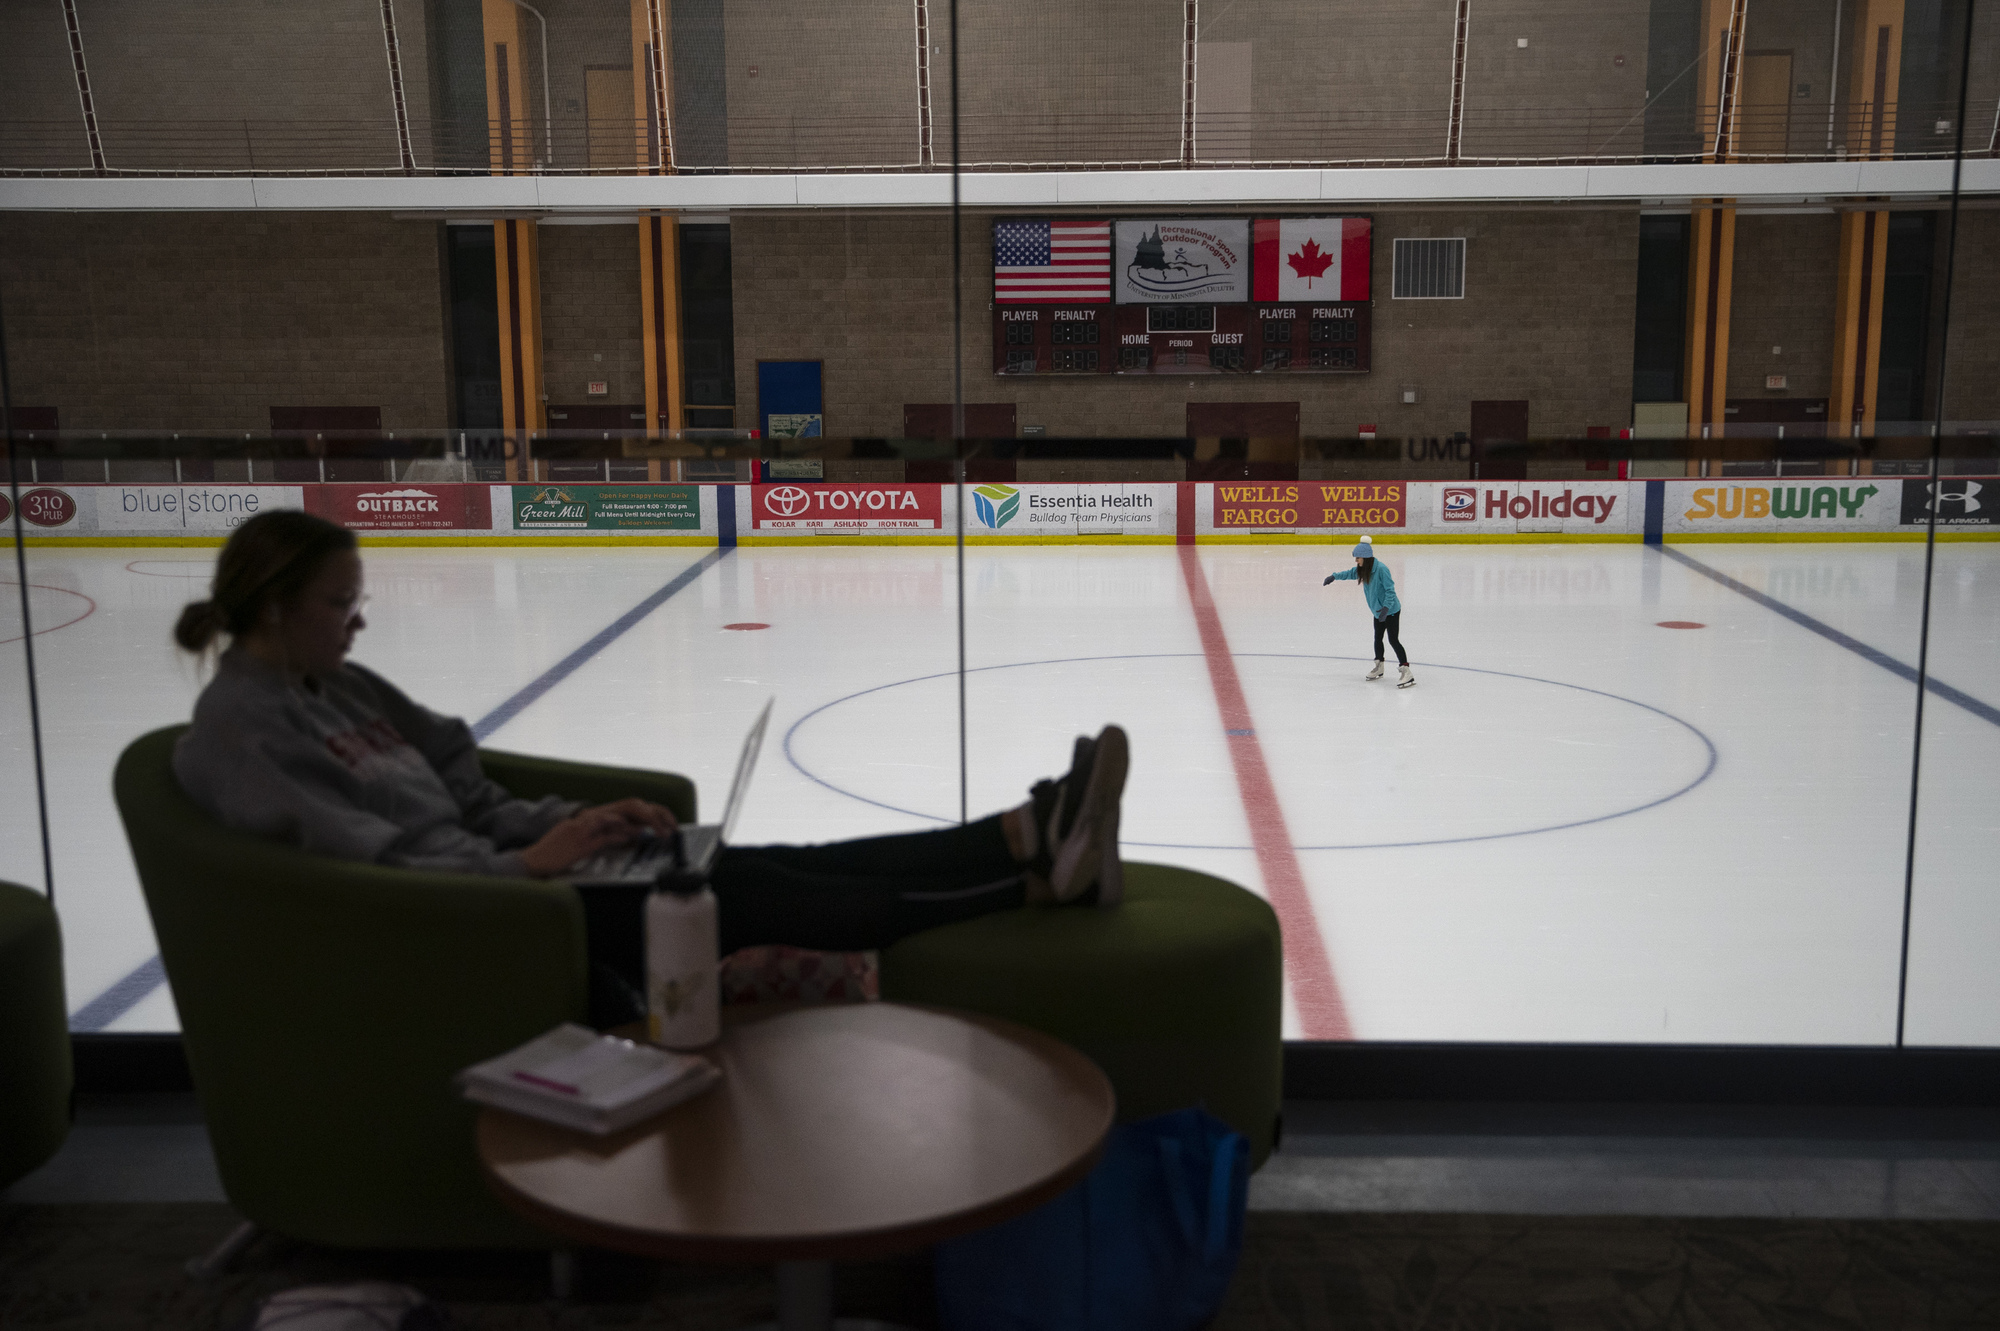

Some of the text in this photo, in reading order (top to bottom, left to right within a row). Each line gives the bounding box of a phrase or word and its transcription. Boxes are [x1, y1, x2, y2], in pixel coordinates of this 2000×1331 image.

[1160, 226, 1238, 264] Recreational Sports
[1162, 234, 1232, 270] Outdoor Program
[1126, 281, 1161, 300] UNIVERSITY
[1170, 289, 1206, 300] MINNESOTA
[1206, 285, 1235, 293] DULUTH
[1002, 311, 1039, 321] PLAYER
[1054, 310, 1096, 321] PENALTY
[1259, 309, 1296, 319] PLAYER
[1312, 308, 1355, 319] PENALTY
[1121, 334, 1150, 345] HOME
[1168, 339, 1193, 347] PERIOD
[1211, 334, 1244, 344] GUEST
[591, 383, 604, 392] EXIT
[452, 437, 519, 461] UMD
[1408, 437, 1476, 461] UMD
[813, 490, 919, 510] TOYOTA
[1029, 494, 1153, 508] Essentia Health
[1219, 486, 1299, 502] WELLS
[1320, 486, 1401, 502] WELLS
[30, 495, 63, 516] 310
[357, 499, 439, 512] OUTBACK
[1485, 489, 1617, 523] Holiday
[1684, 483, 1879, 522] SUBWAY
[43, 510, 63, 520] PUB
[520, 504, 585, 522] Green Mill
[1029, 513, 1152, 524] Bulldog Team Physicians
[1221, 508, 1298, 525] FARGO
[1322, 508, 1399, 524] FARGO
[1445, 511, 1474, 519] Holiday
